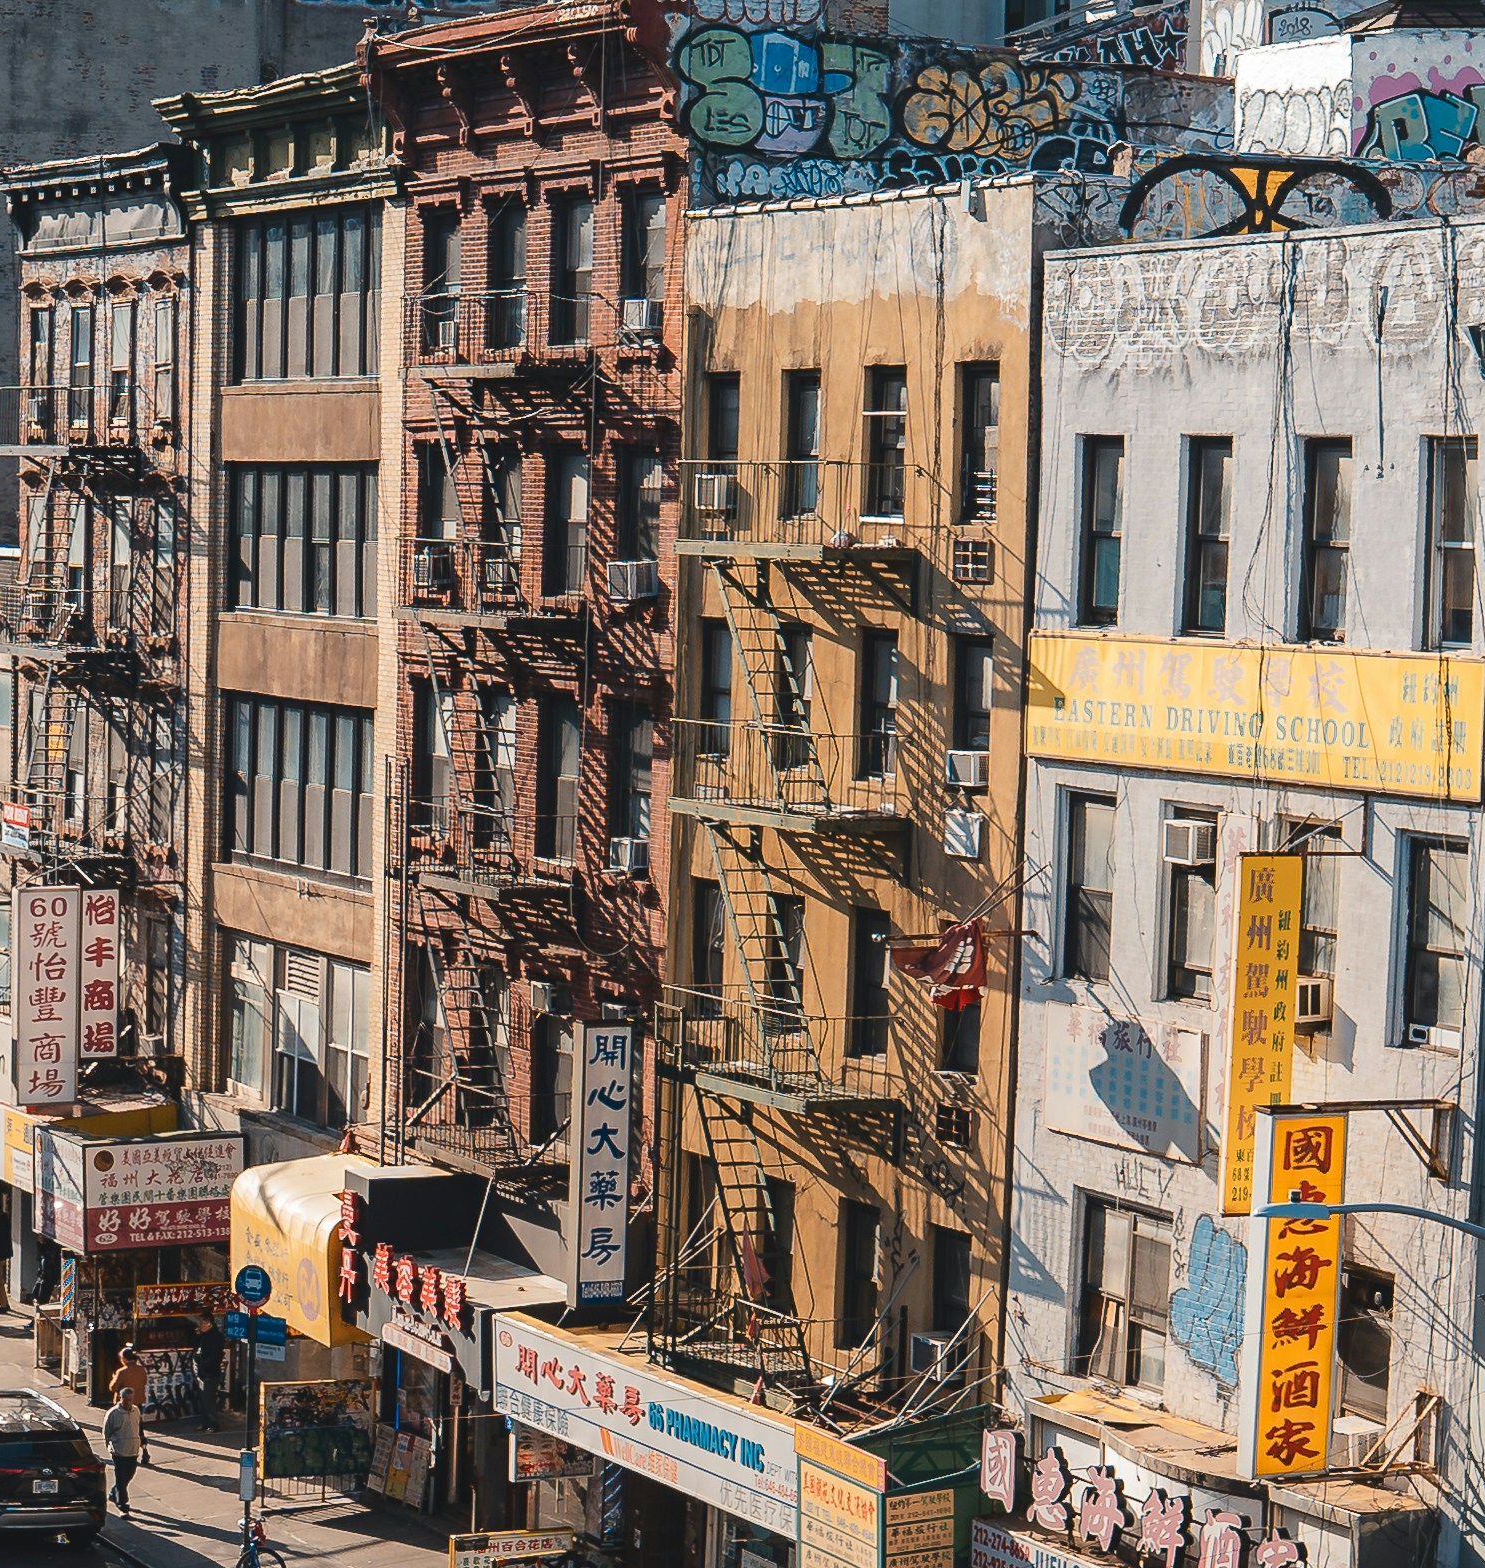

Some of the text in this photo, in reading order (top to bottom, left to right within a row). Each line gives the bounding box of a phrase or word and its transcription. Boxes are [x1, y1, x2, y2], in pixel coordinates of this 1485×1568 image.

[1067, 645, 1349, 714] 廣州駕駛學校
[1054, 697, 1371, 749] EASTERN DRIVING SCHOOL
[1235, 865, 1278, 1141] 廣州駕駛學校
[100, 1167, 205, 1190] 福州大花店
[588, 1034, 628, 1266] 開心大藥房
[130, 1232, 146, 1243] TEL
[156, 1230, 175, 1241] FAX:
[1265, 1125, 1333, 1468] 國惠海鮮酒家
[515, 1343, 646, 1426] 開心大藥房
[648, 1401, 665, 1432] 66
[666, 1412, 738, 1461] PHARMACY
[740, 1437, 766, 1474] INC
